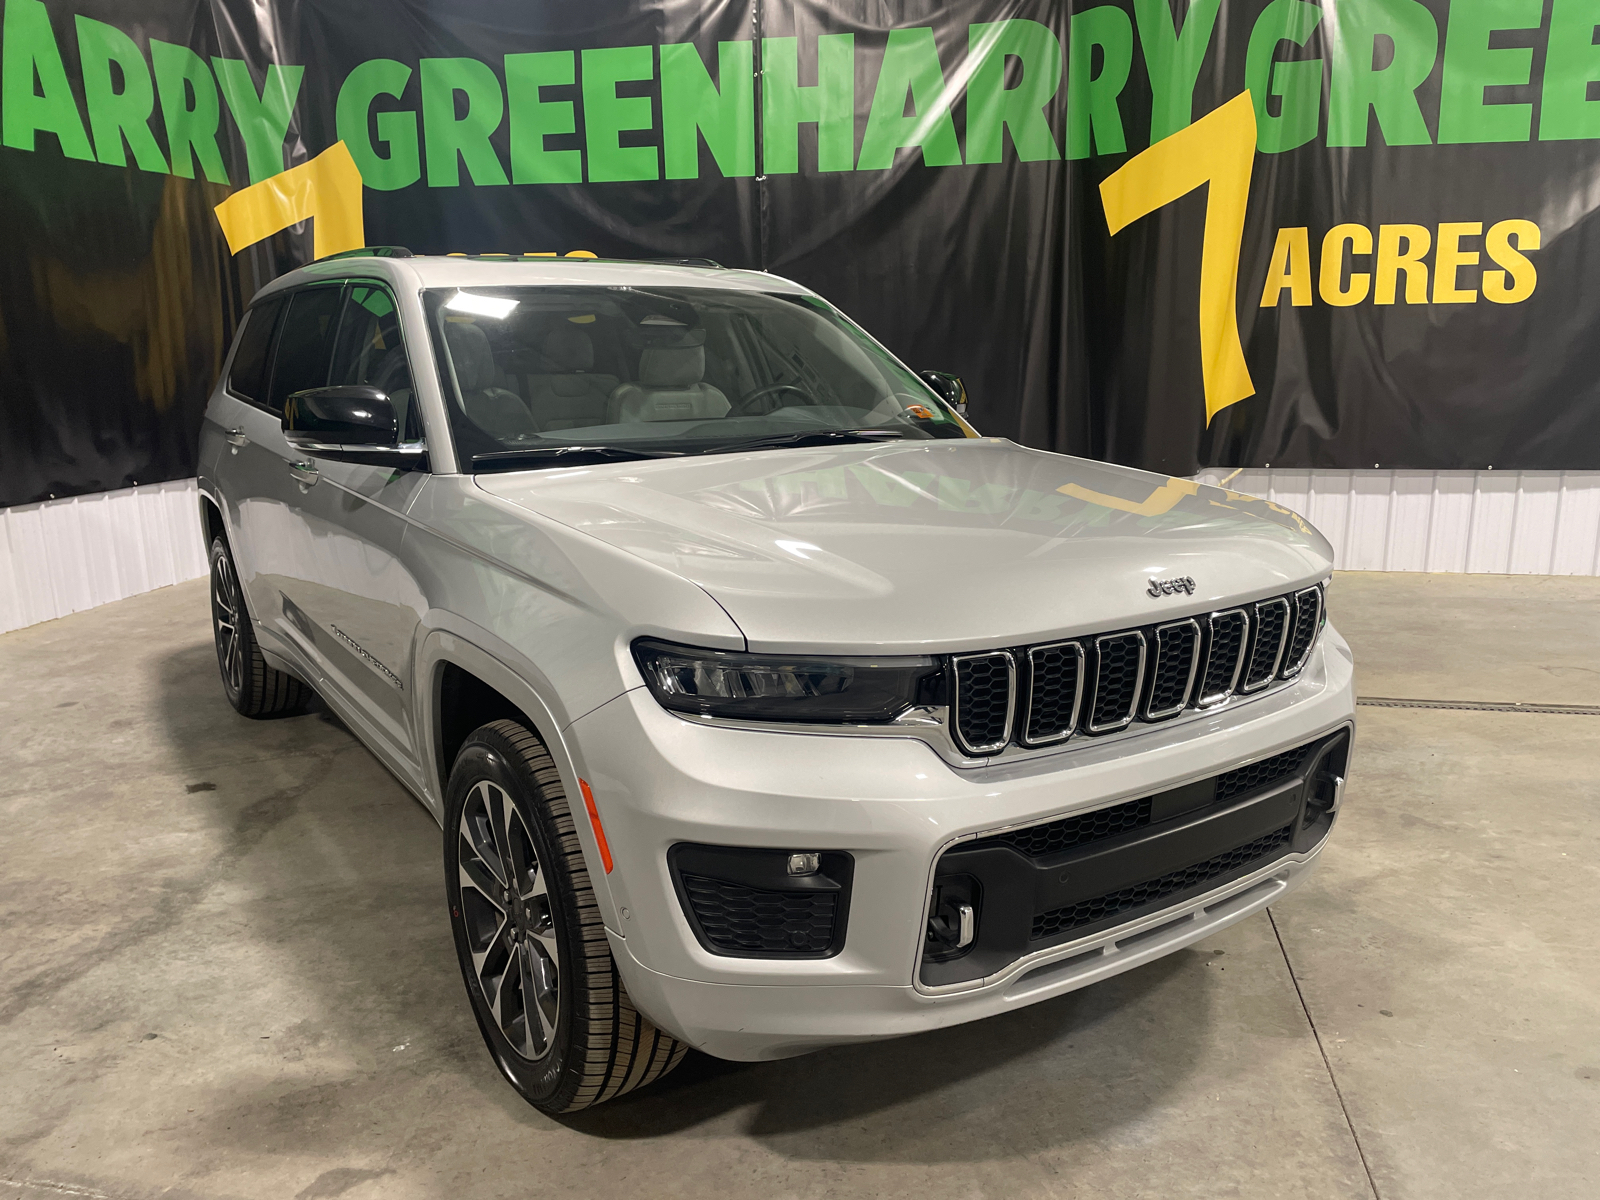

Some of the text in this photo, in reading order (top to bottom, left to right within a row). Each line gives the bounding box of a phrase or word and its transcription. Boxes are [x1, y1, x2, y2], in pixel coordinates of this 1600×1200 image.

[0, 0, 756, 191] ARRY GREEN
[761, 0, 1217, 176] HARRY
[1099, 88, 1541, 429] 7 ACRES
[1146, 575, 1196, 600] Jeep
